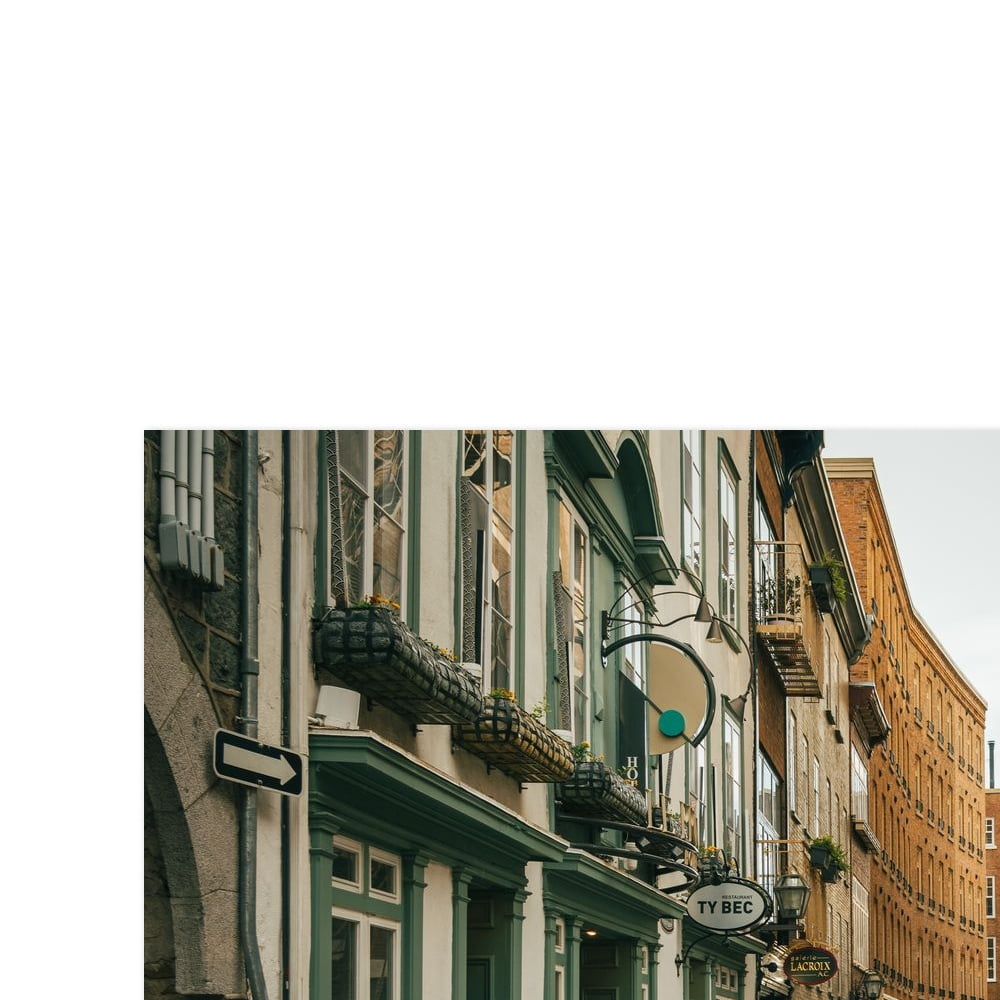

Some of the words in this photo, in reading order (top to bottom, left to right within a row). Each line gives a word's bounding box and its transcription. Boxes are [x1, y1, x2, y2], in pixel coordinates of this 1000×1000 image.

[697, 901, 717, 914] TY
[721, 901, 753, 914] BEC
[790, 962, 831, 972] LACROIX
